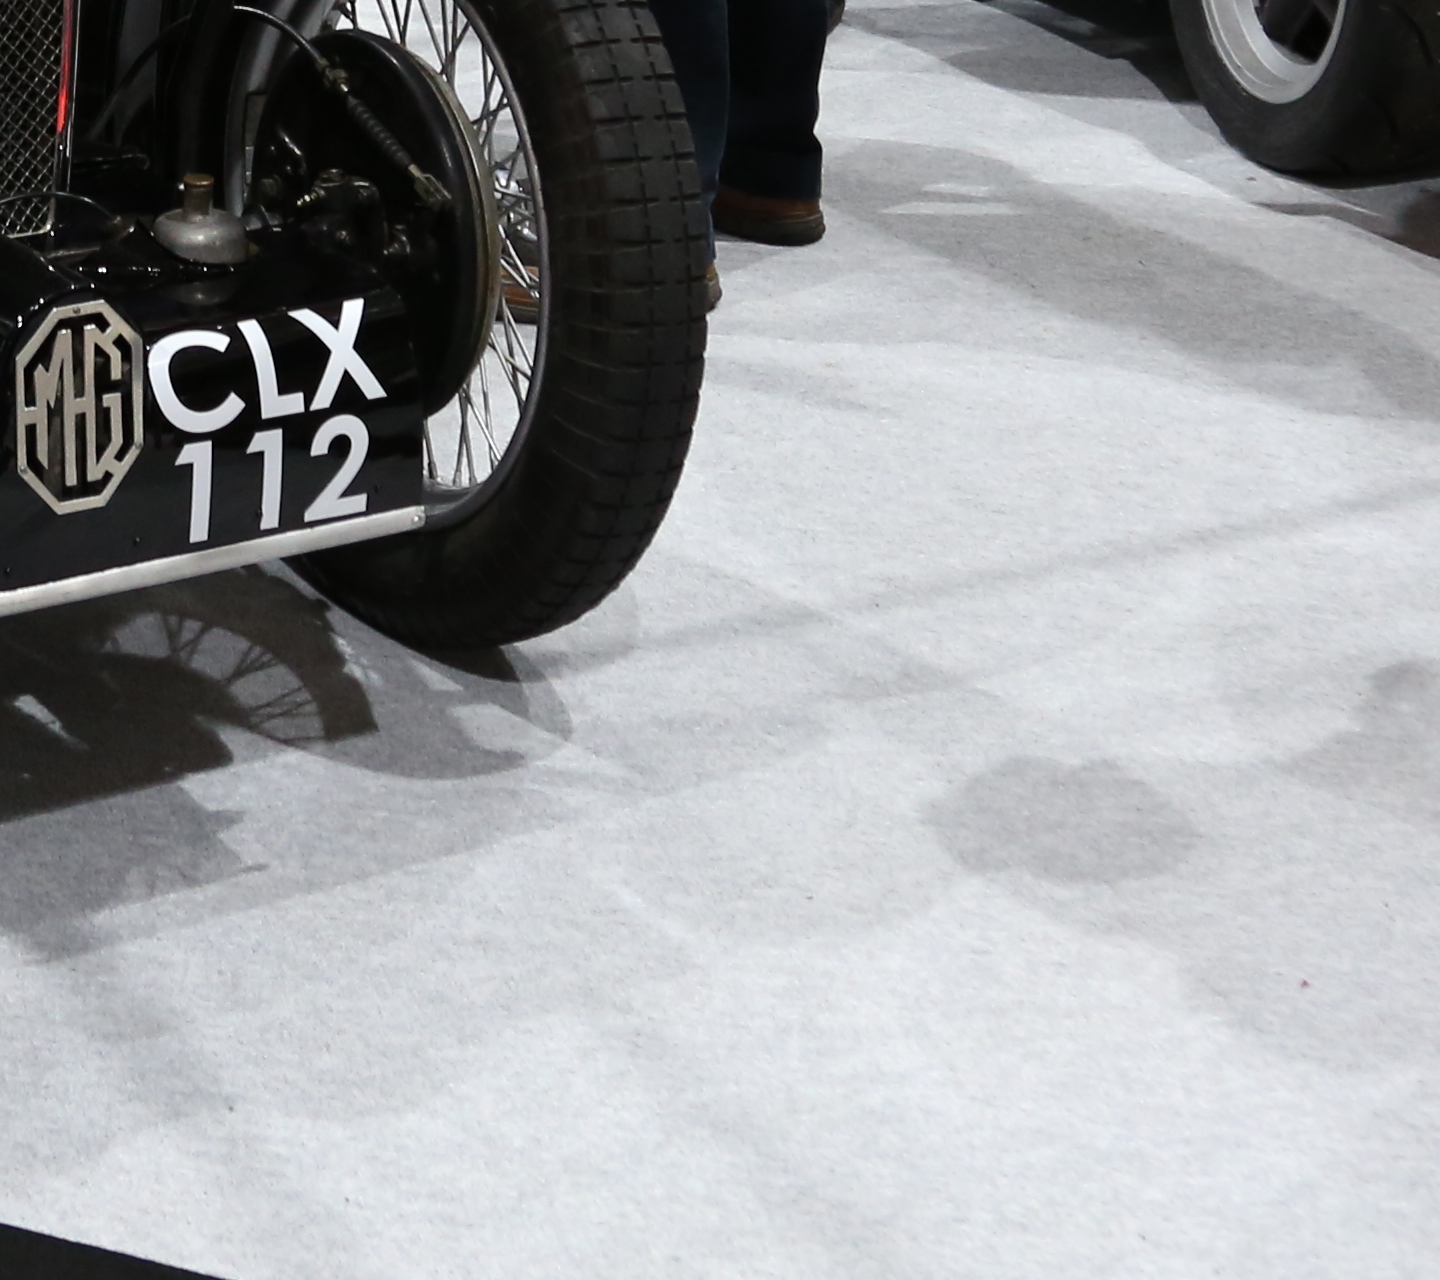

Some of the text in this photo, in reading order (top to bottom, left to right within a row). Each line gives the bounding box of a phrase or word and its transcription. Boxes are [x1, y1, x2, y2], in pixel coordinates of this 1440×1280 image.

[20, 320, 140, 500] MG
[147, 297, 388, 433] CLX
[175, 414, 369, 544] 112
